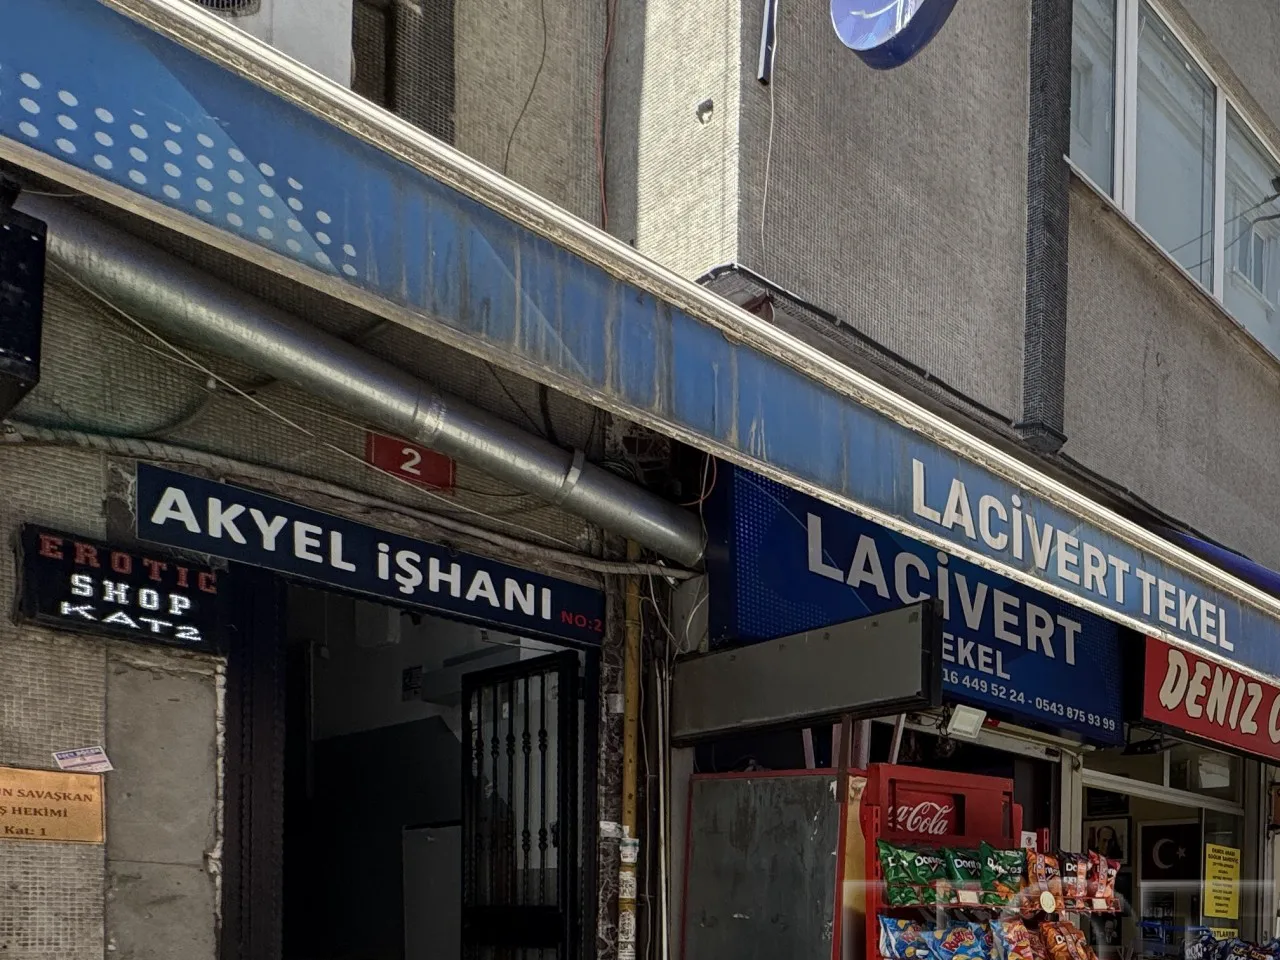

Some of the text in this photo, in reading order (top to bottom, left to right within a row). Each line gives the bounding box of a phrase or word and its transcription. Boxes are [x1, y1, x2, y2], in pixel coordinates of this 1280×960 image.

[400, 447, 422, 475] 2
[150, 486, 357, 572] AKYEL
[39, 533, 218, 595] EROTIC
[912, 457, 1235, 652] LACİVERT TEKEL
[70, 573, 192, 616] SHOP
[807, 512, 1083, 666] LACİVERT
[942, 633, 1011, 681] EKEL
[942, 668, 959, 685] 16
[962, 674, 988, 694] 449
[991, 682, 1007, 698] 52
[1008, 688, 1026, 705] 24
[1035, 697, 1065, 717] 0543
[1066, 706, 1086, 723] 875
[1087, 712, 1102, 727] 93
[1102, 718, 1116, 732] 99
[12, 806, 69, 818] HEKİMİ
[17, 788, 93, 802] SAVAŞKAN
[4, 825, 47, 837] Kat: 1
